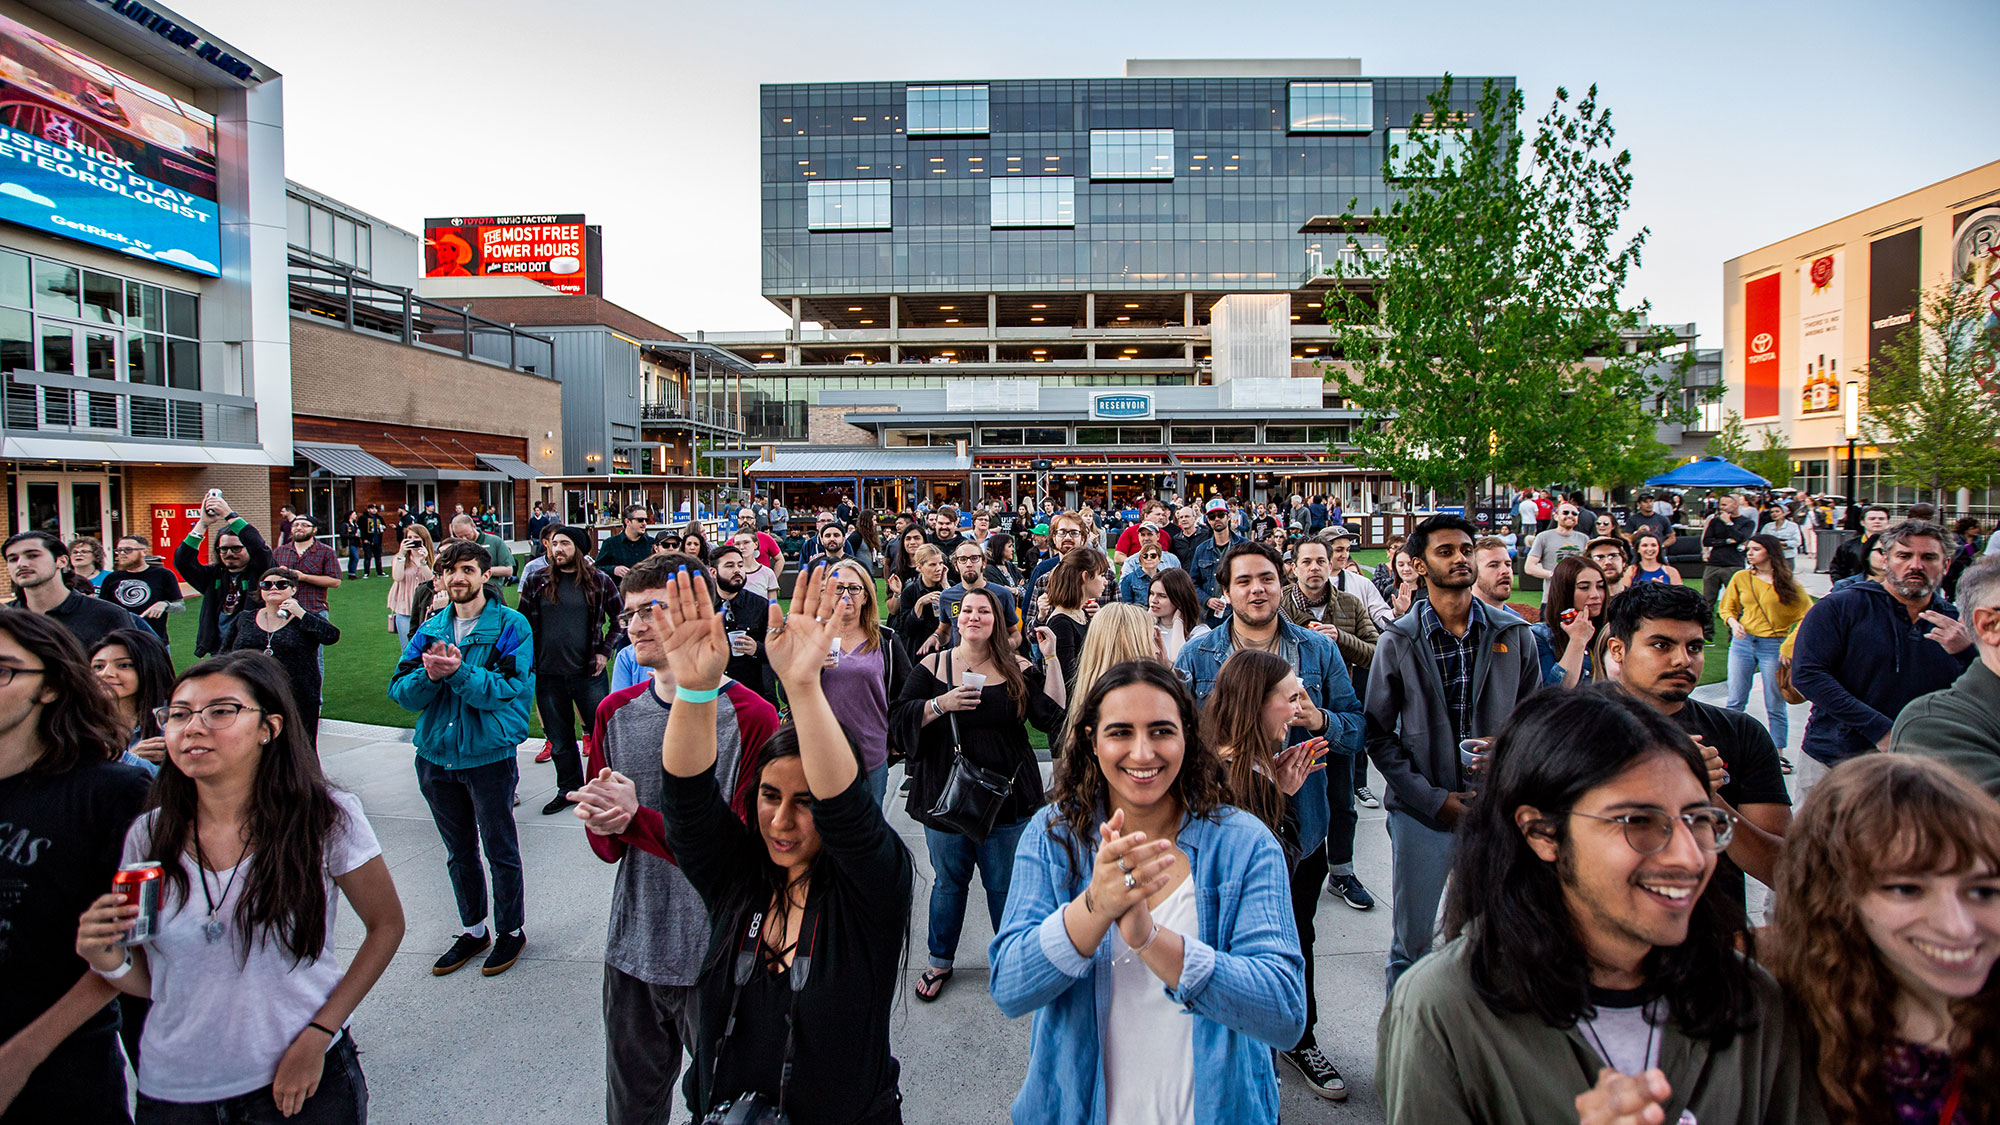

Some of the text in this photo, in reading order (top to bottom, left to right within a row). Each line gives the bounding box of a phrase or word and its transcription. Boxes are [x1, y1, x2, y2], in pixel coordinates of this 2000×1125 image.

[65, 138, 136, 174] RICK
[81, 157, 122, 181] TO
[128, 174, 196, 206] PLAY
[463, 217, 495, 225] TOYOTA
[522, 215, 558, 224] FACTORY
[50, 214, 153, 250] GetRick.tv
[484, 225, 580, 244] THE MOST FREE
[484, 242, 580, 258] POWER HOURS
[487, 261, 547, 273] plus ECHO DOT
[1872, 313, 1911, 330] verizon
[1748, 352, 1776, 364] TOYOTA
[1100, 401, 1145, 410] RESERVOIR
[155, 509, 174, 518] ATM
[160, 518, 171, 547] ATM
[748, 912, 763, 938] EOS
